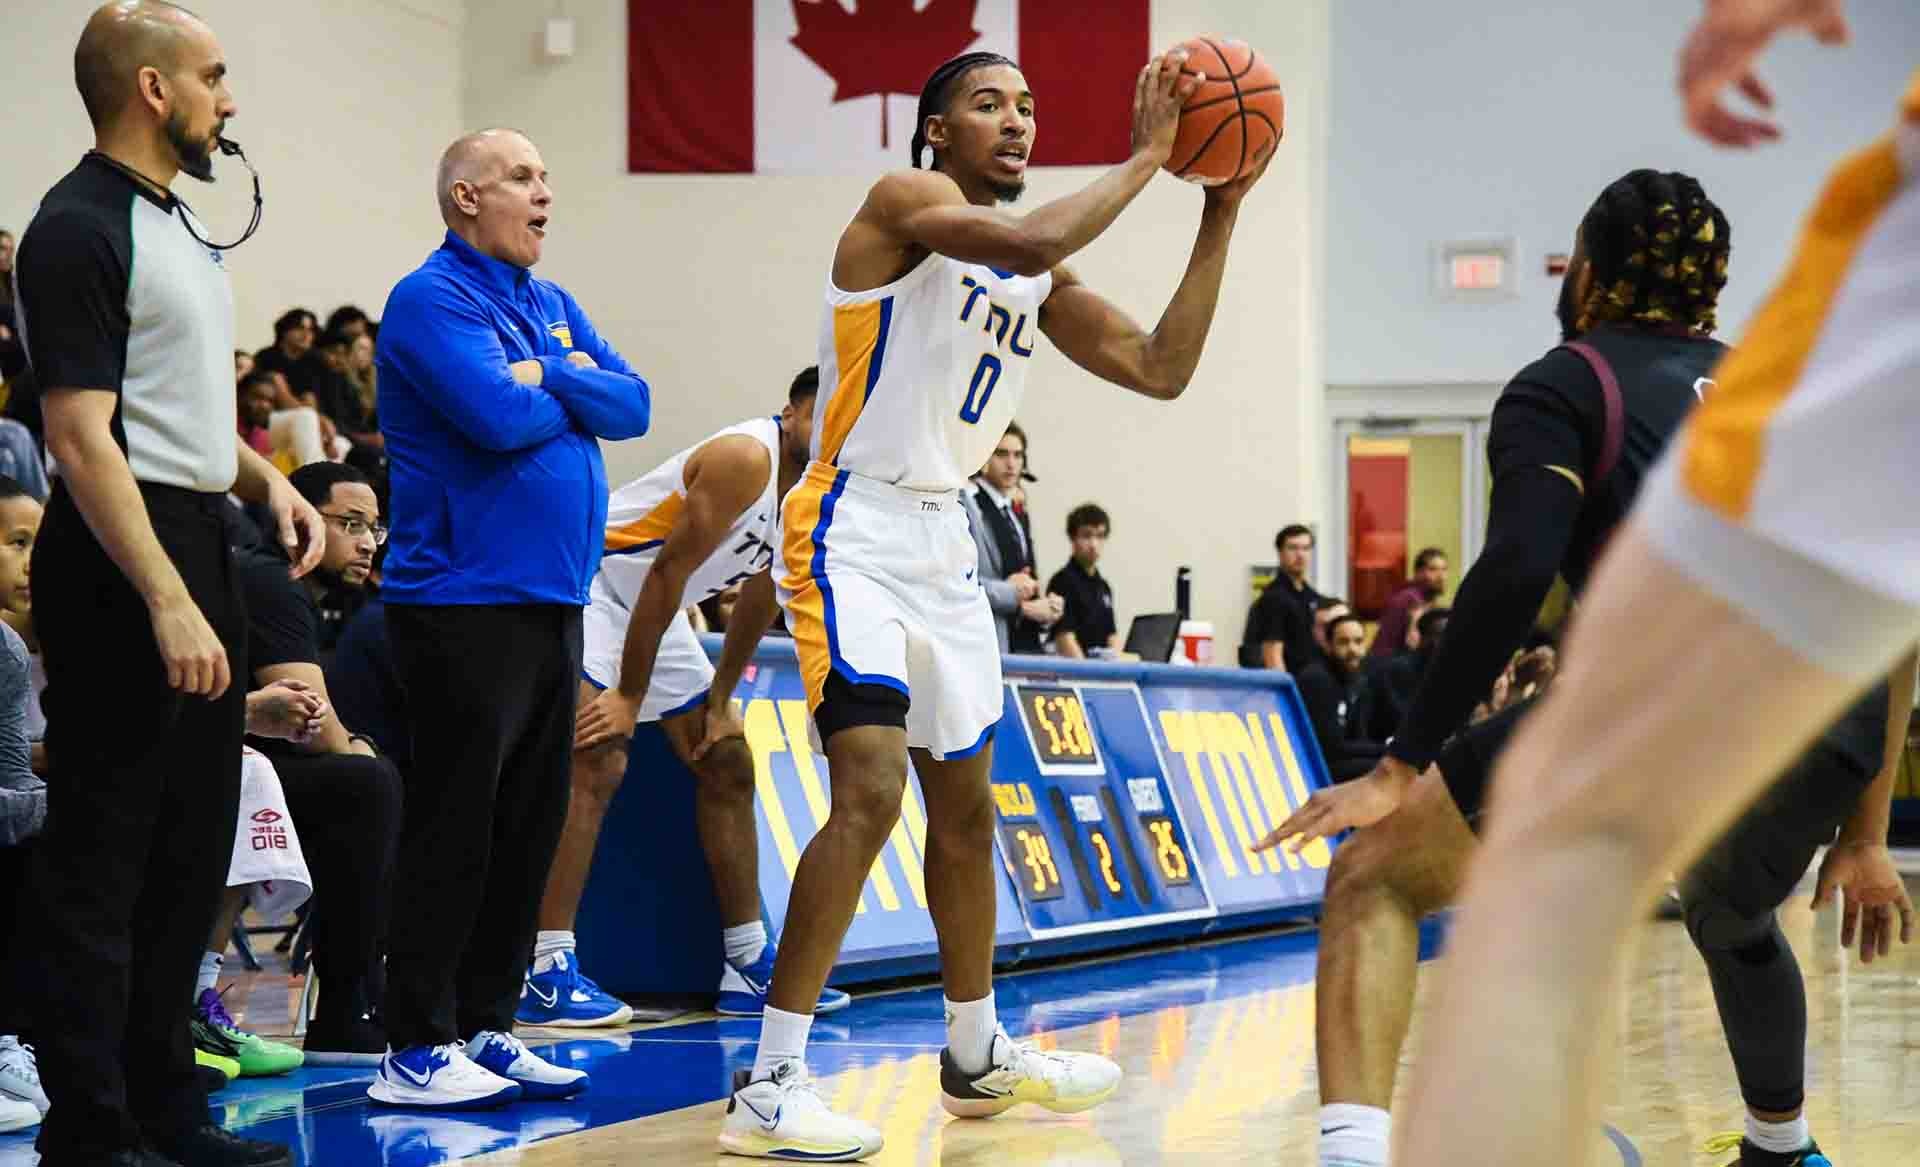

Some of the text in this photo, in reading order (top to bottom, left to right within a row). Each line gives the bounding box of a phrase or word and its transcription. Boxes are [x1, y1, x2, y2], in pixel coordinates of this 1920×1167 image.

[961, 274, 1035, 358] TMU
[960, 352, 1003, 425] 0
[921, 500, 944, 512] TMU
[1158, 711, 1332, 878] TMU
[252, 834, 288, 851] BIO
[1016, 829, 1060, 893] 34
[1090, 832, 1121, 893] 2
